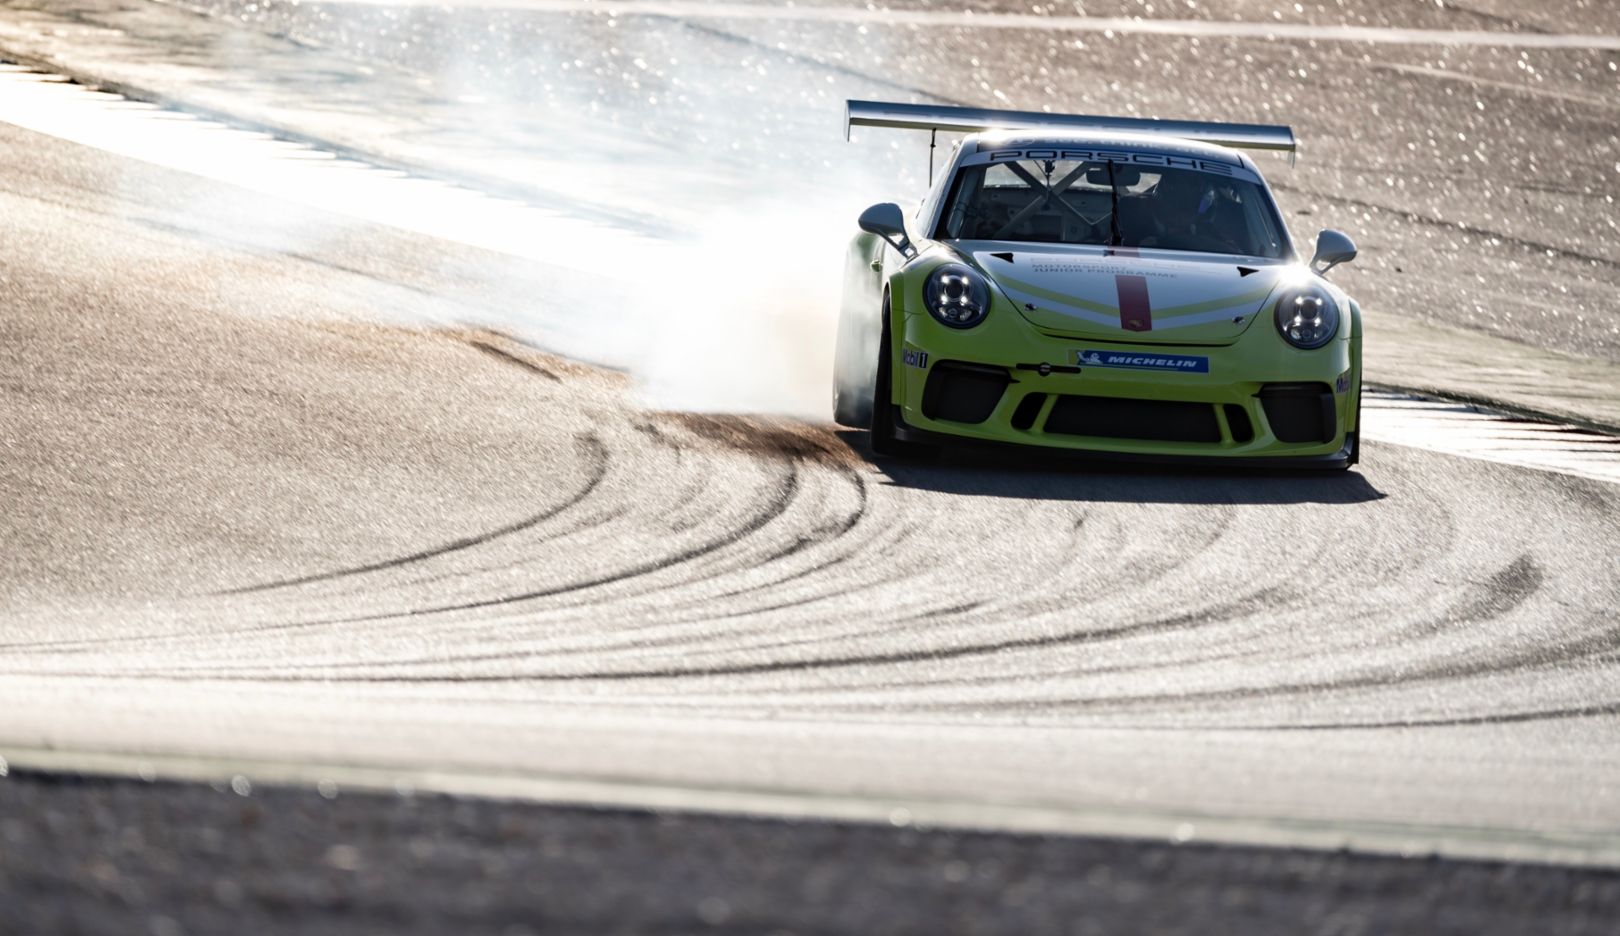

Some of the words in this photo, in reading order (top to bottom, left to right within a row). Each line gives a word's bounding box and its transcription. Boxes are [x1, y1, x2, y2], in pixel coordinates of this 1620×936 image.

[990, 150, 1232, 175] PORSCHE
[1031, 263, 1127, 271] MOTORSPORT
[1087, 268, 1178, 279] PROGRAMME
[919, 351, 928, 369] 1
[1107, 355, 1197, 368] MICHELIN
